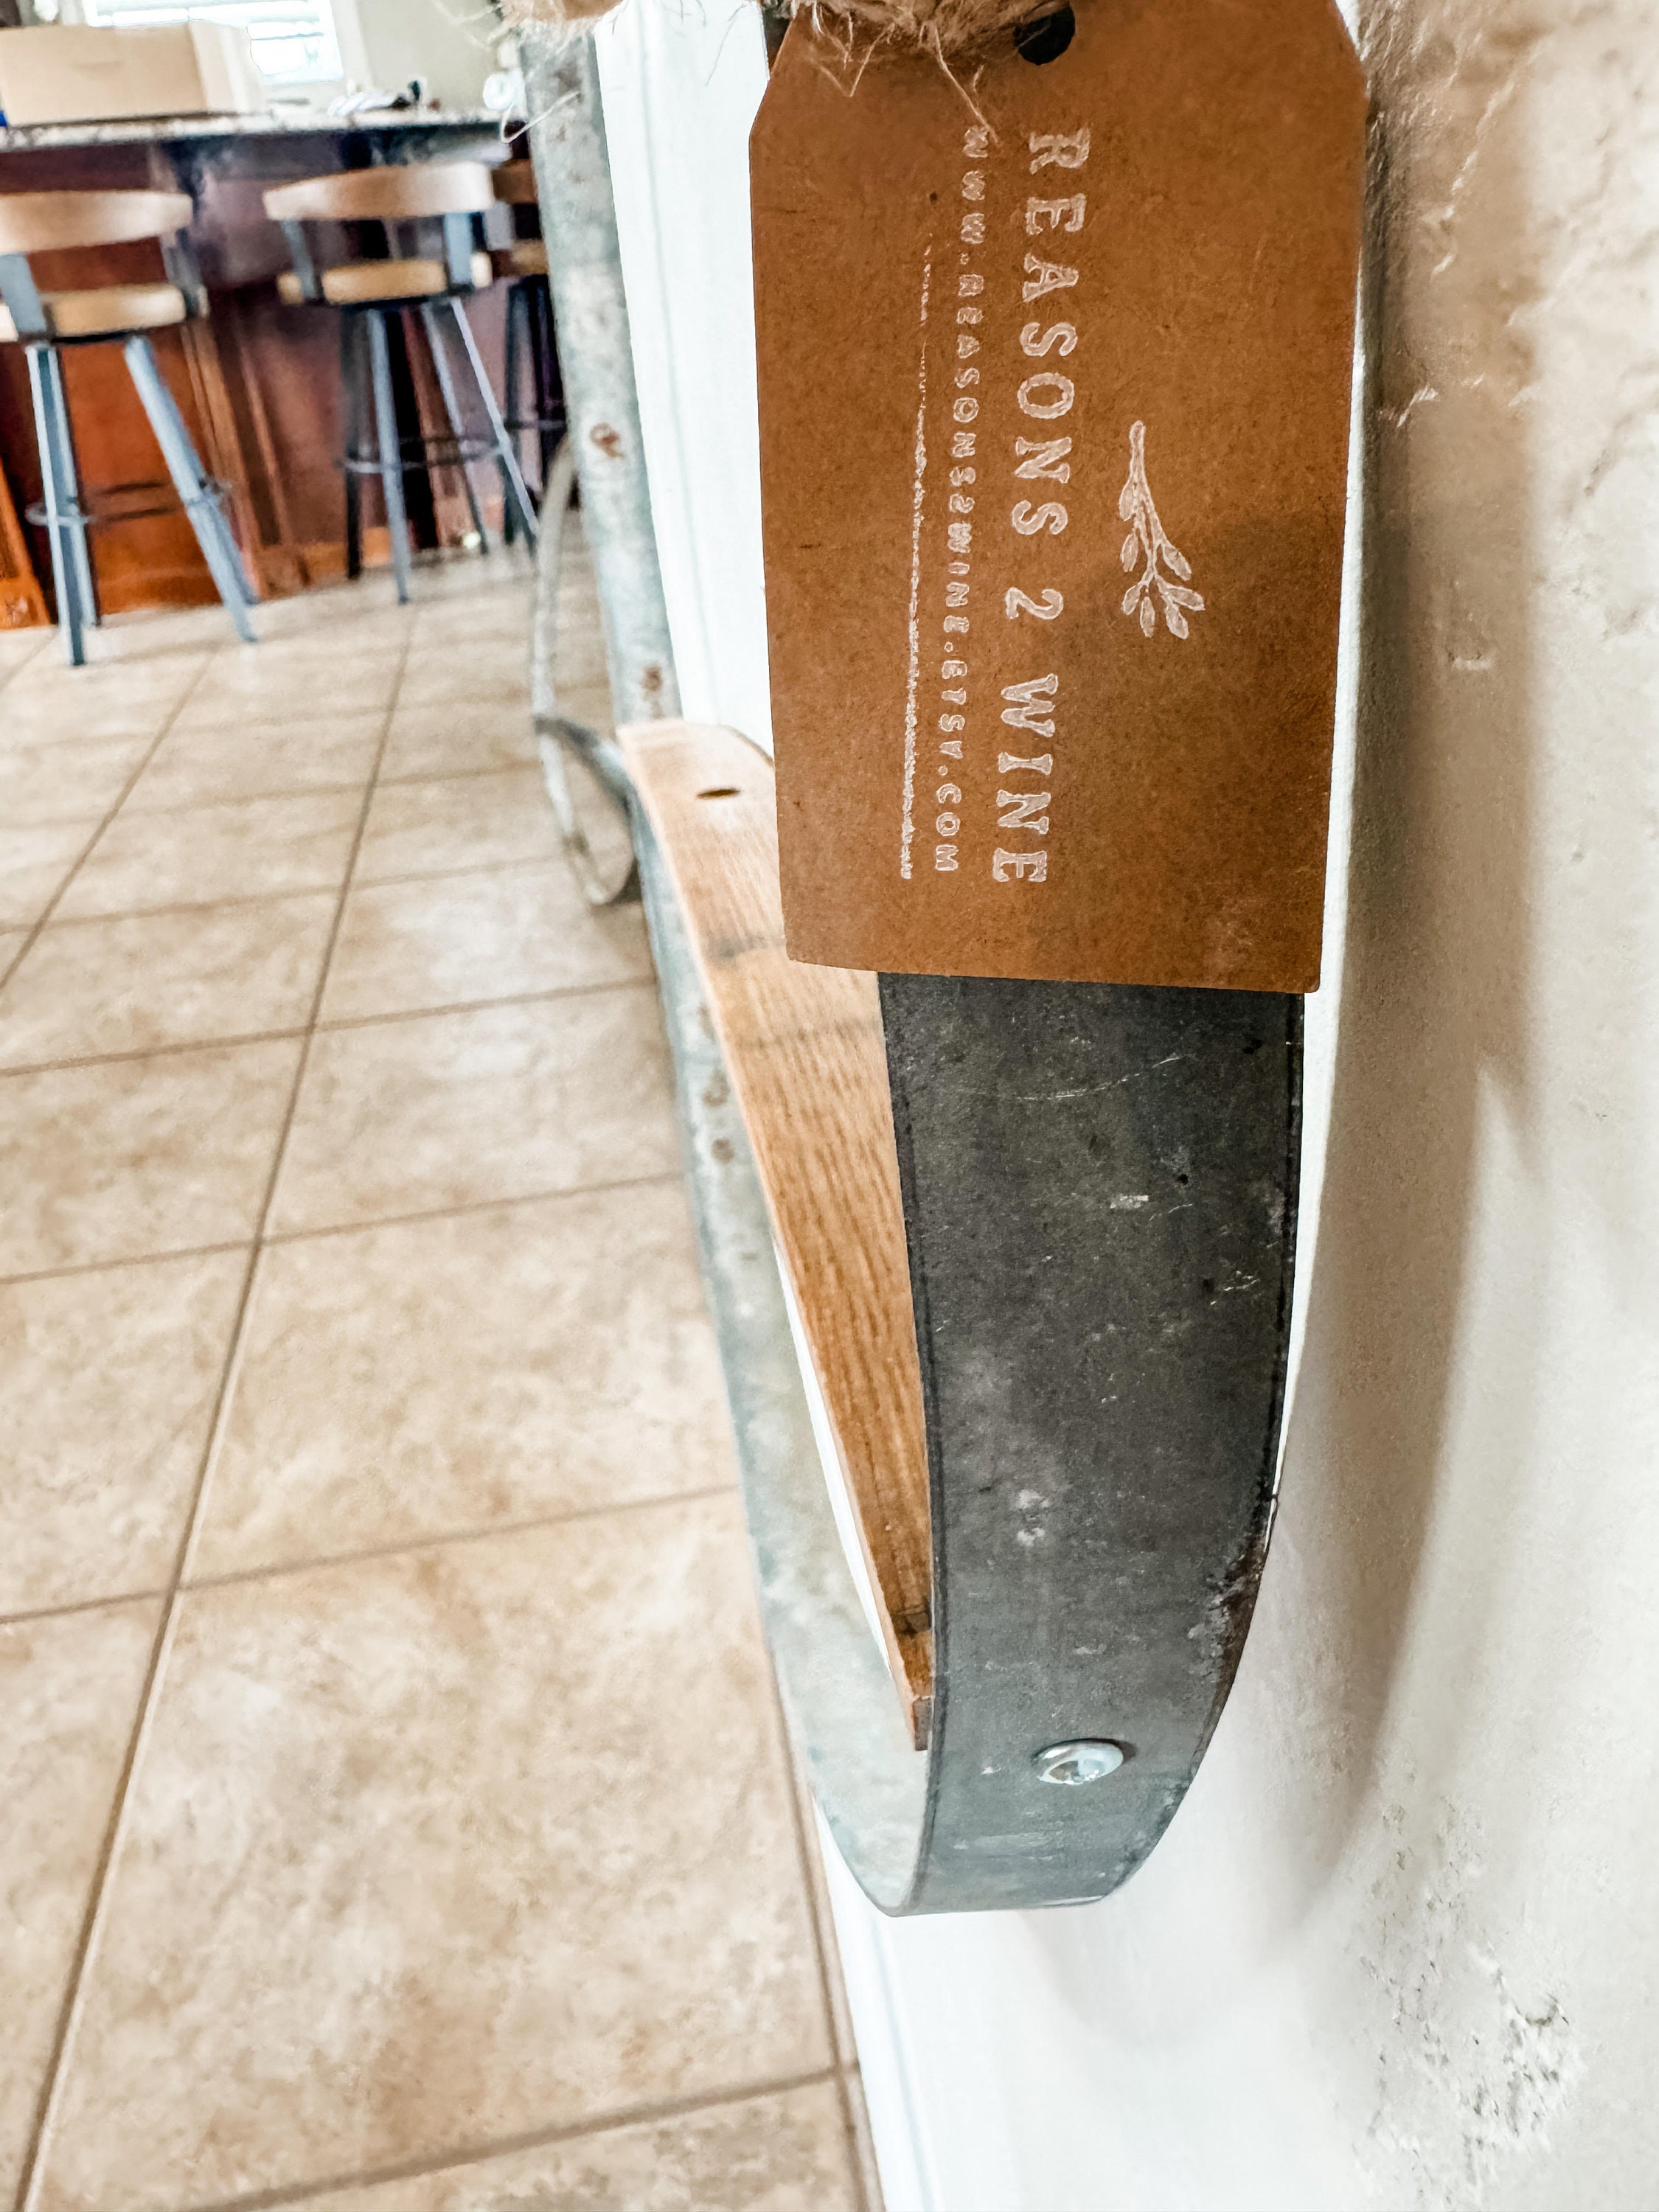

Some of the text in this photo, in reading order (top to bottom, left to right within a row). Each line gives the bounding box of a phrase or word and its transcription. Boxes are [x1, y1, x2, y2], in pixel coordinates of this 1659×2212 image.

[992, 128, 1091, 883] REASONS 2 WINE
